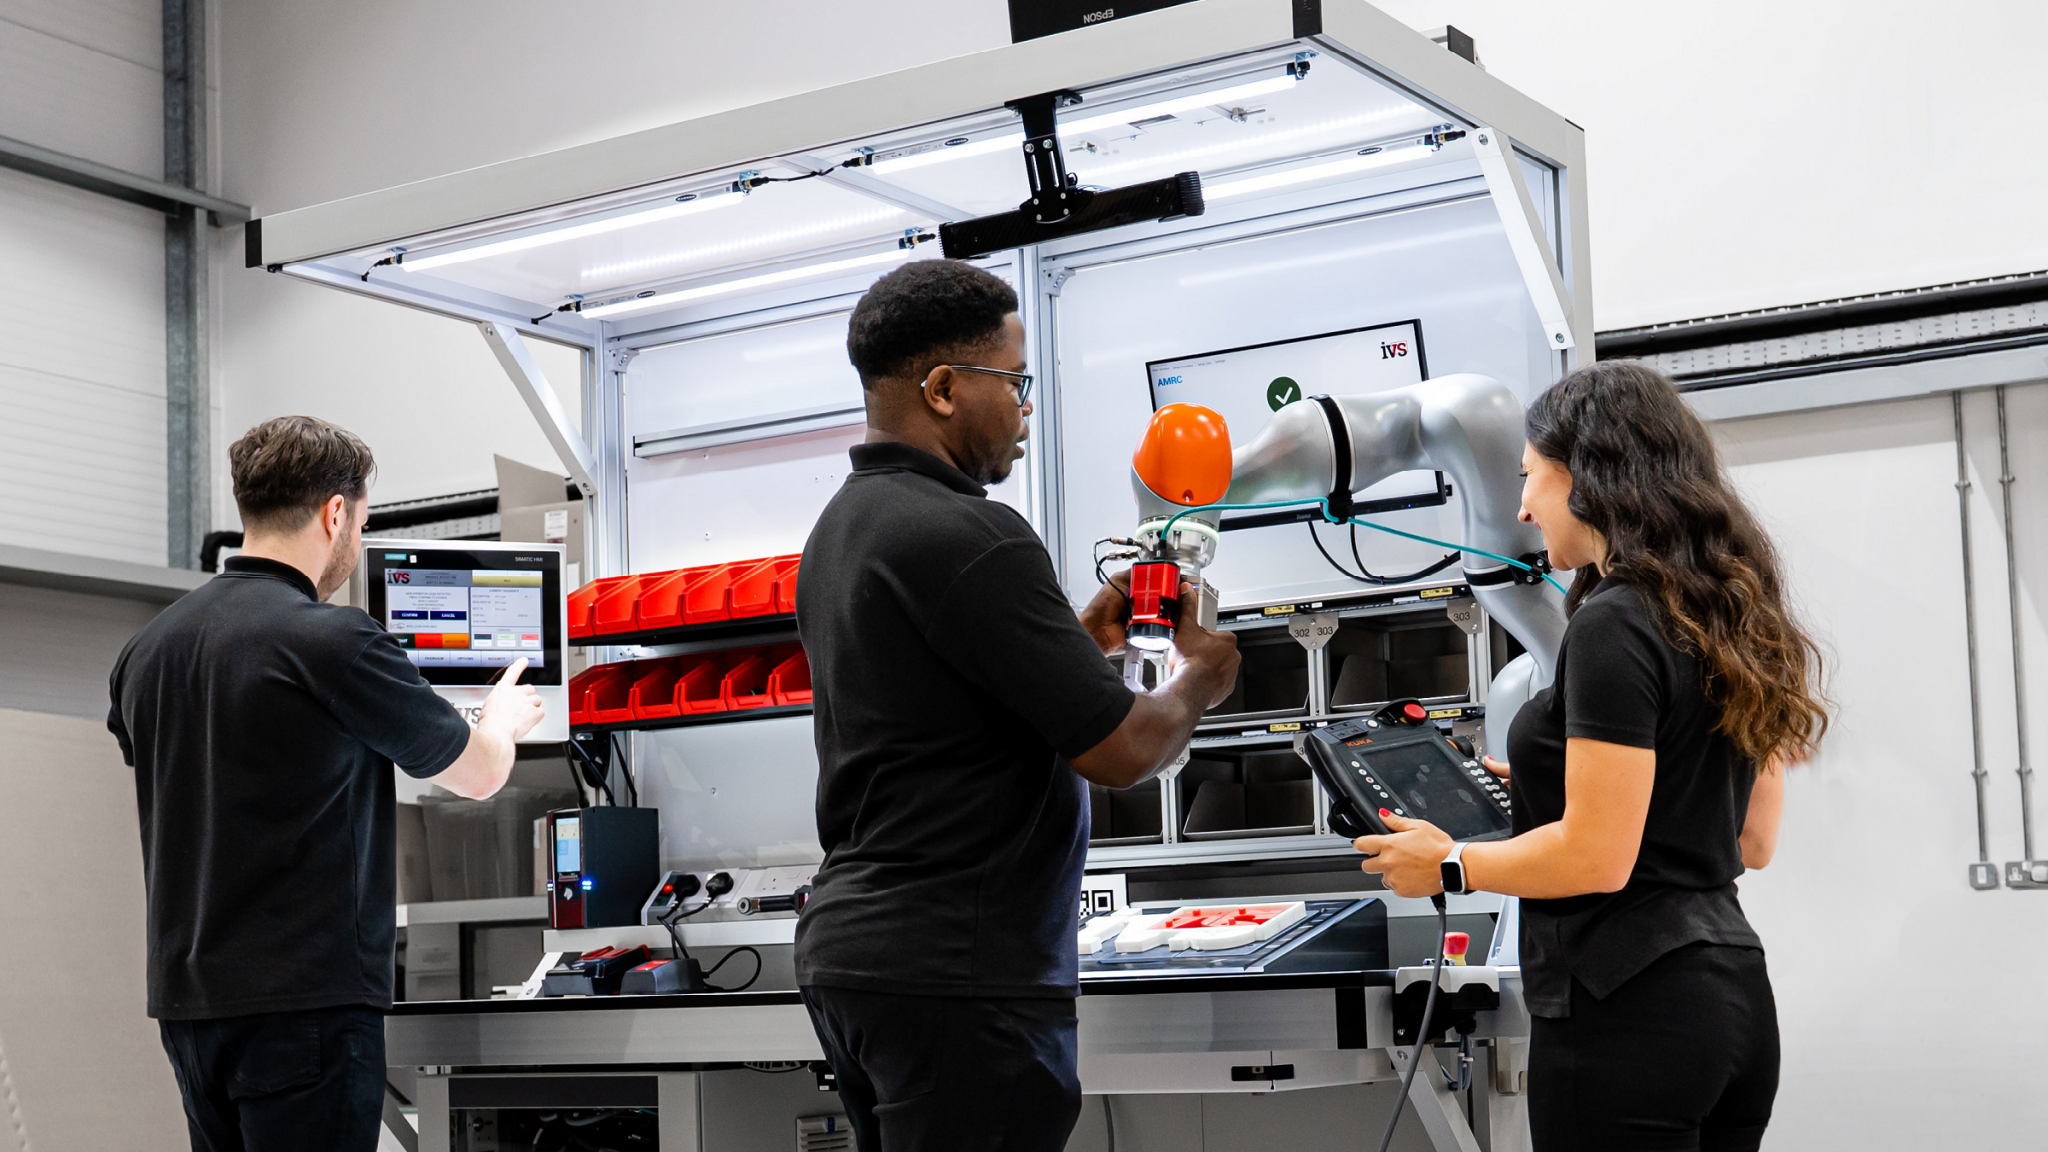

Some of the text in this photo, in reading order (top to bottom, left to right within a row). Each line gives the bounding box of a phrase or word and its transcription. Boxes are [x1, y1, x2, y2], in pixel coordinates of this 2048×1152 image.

[1083, 8, 1114, 24] EPSON
[1158, 375, 1183, 387] AMRC
[1453, 611, 1471, 622] 303
[1294, 626, 1333, 638] 302 303
[1346, 738, 1373, 747] KUKA
[1172, 756, 1186, 767] 05
